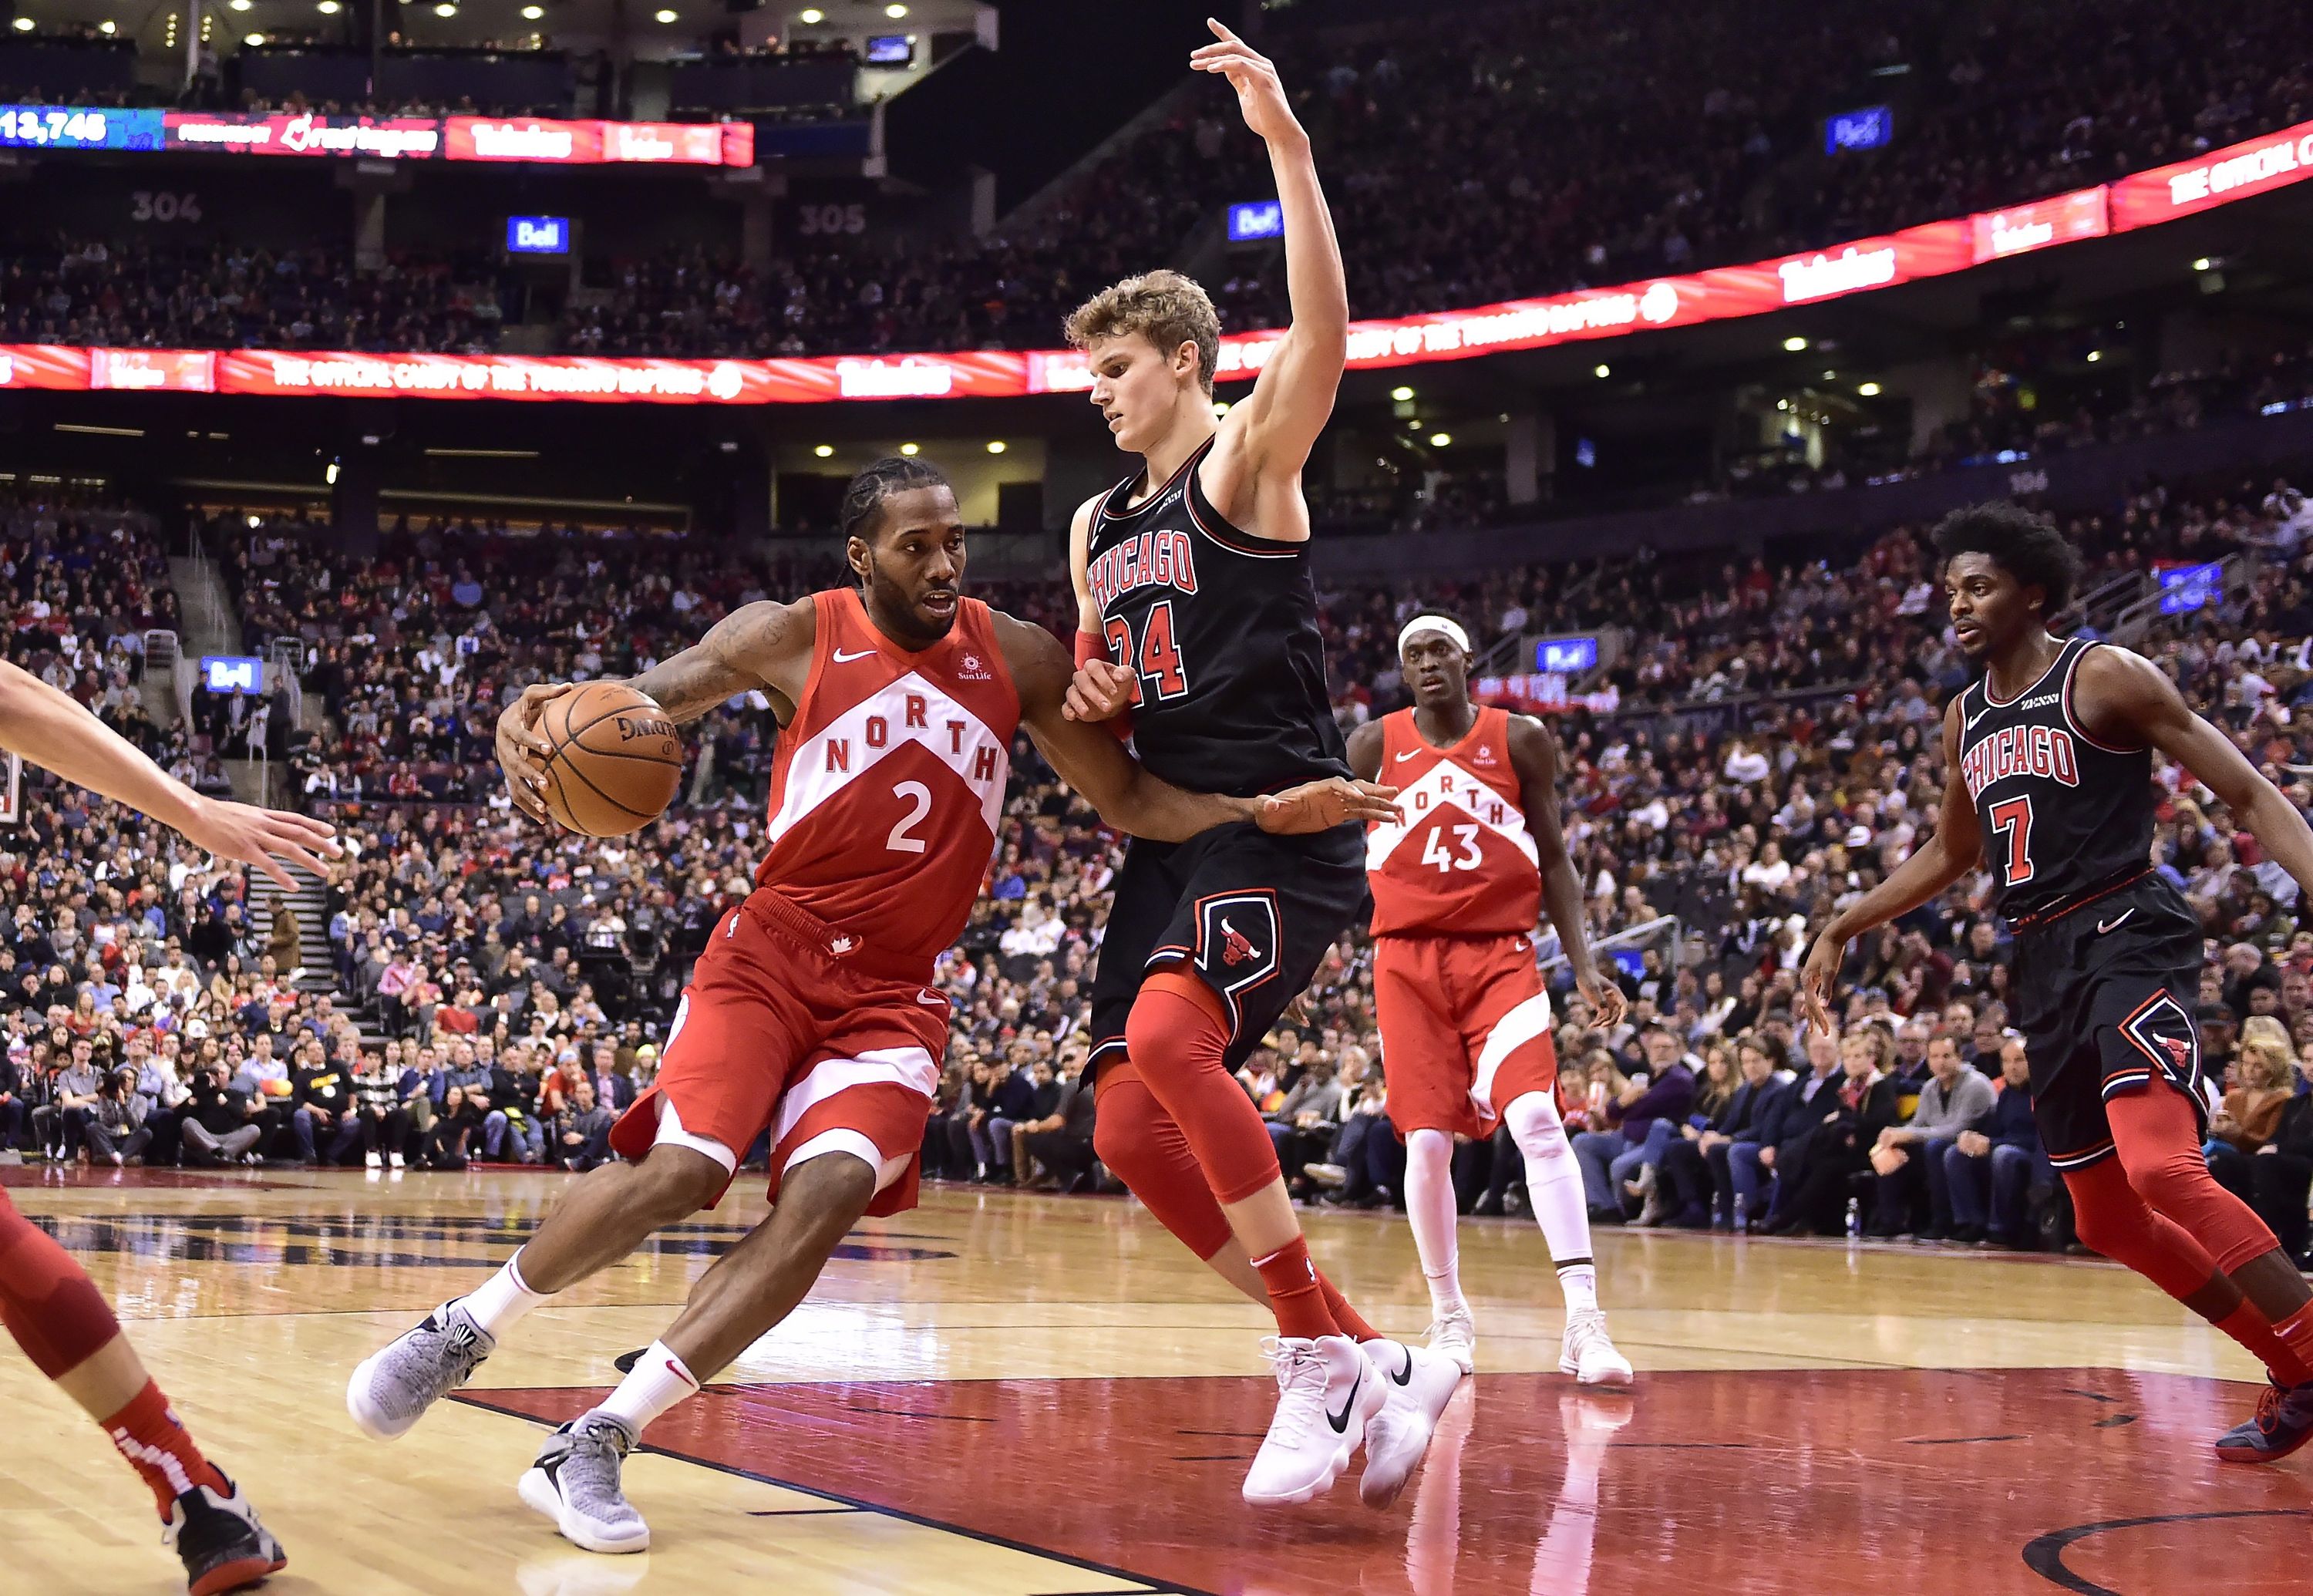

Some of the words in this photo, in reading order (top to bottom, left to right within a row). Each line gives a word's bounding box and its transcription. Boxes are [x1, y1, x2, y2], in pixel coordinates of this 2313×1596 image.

[132, 192, 201, 222] 304
[518, 222, 558, 246] Bell
[958, 672, 975, 680] Sun
[975, 672, 992, 680] Life
[1103, 600, 1188, 709] 24
[826, 694, 998, 781] NORTH
[886, 780, 931, 853] 2
[1989, 793, 2034, 887] 7
[1422, 824, 1483, 873] 43
